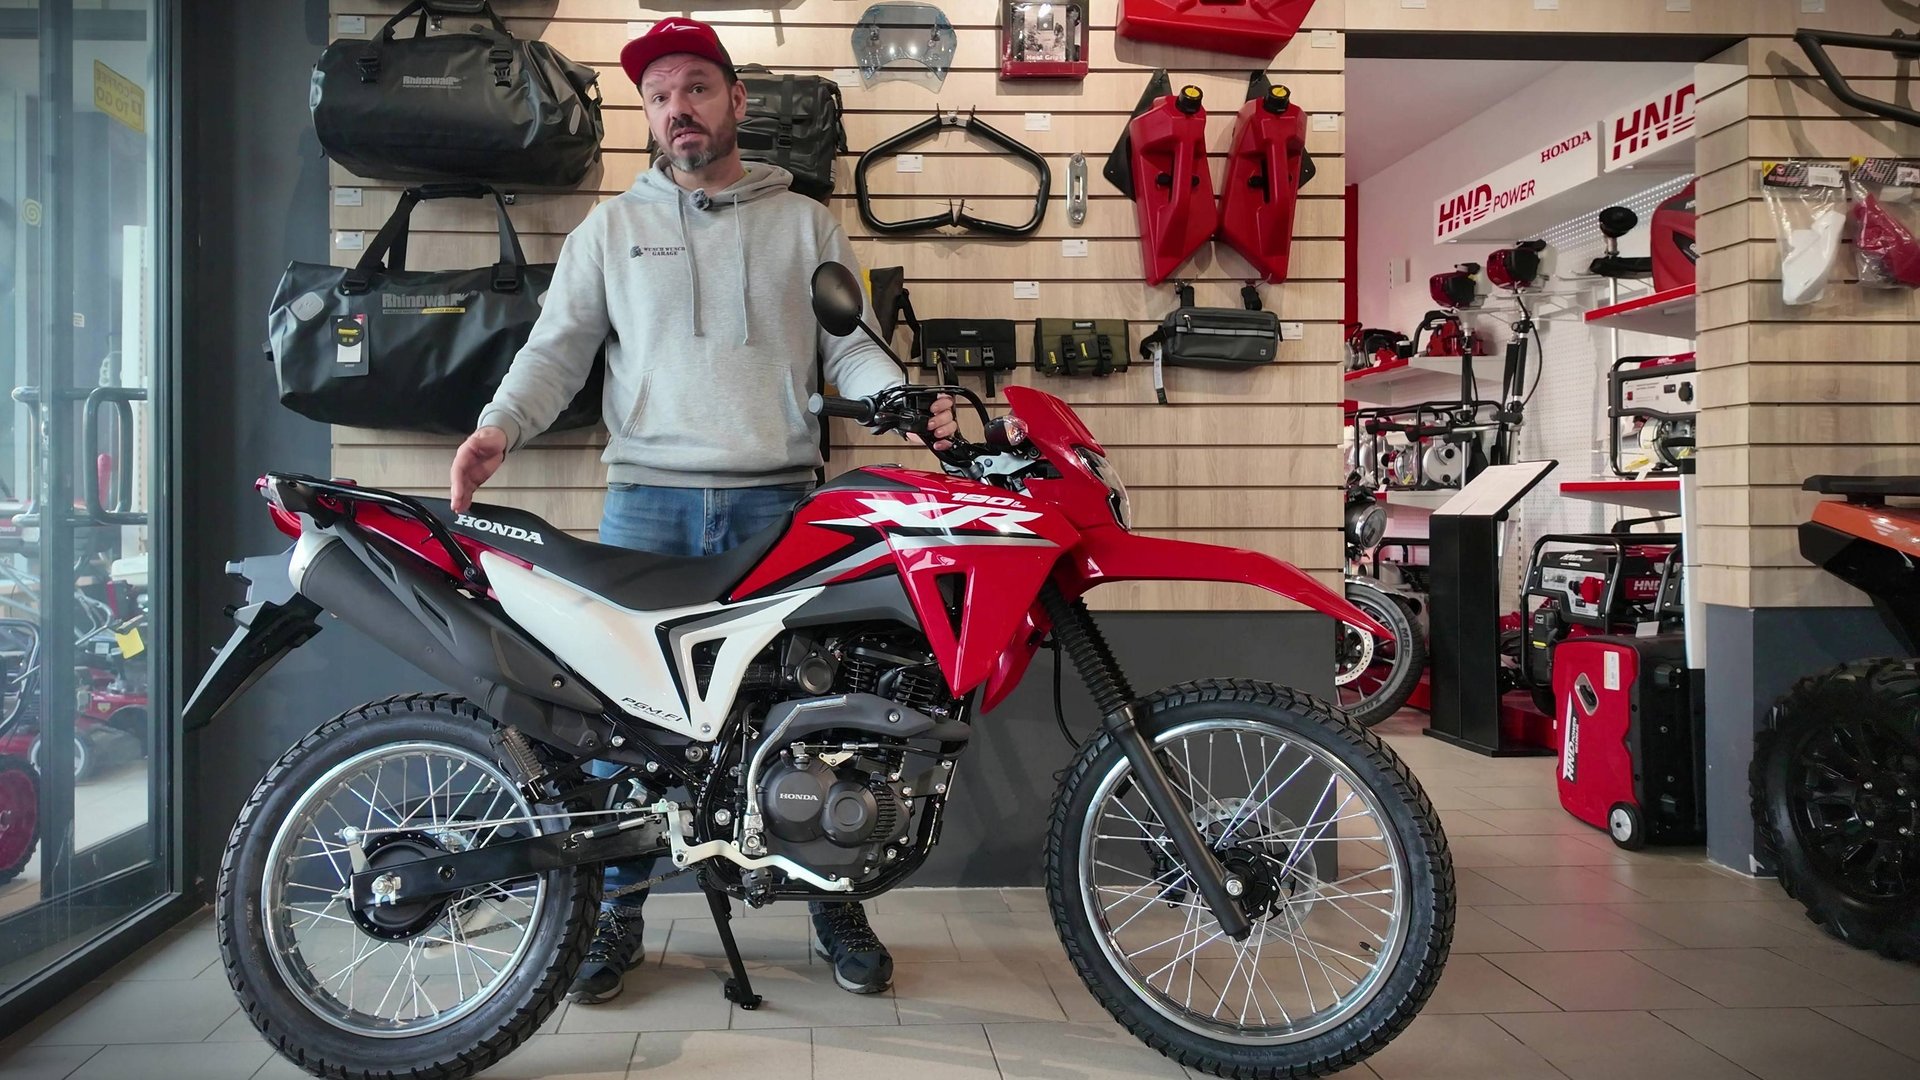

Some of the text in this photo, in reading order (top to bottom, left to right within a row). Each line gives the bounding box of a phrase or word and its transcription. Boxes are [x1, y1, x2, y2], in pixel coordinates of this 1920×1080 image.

[1612, 83, 1696, 161] HND
[1541, 131, 1592, 163] HONDA
[1438, 179, 1535, 236] HND POWER
[382, 292, 469, 308] Rhinowalk
[454, 513, 545, 545] HONDA
[808, 498, 1043, 535] XR
[780, 793, 819, 801] HONDA
